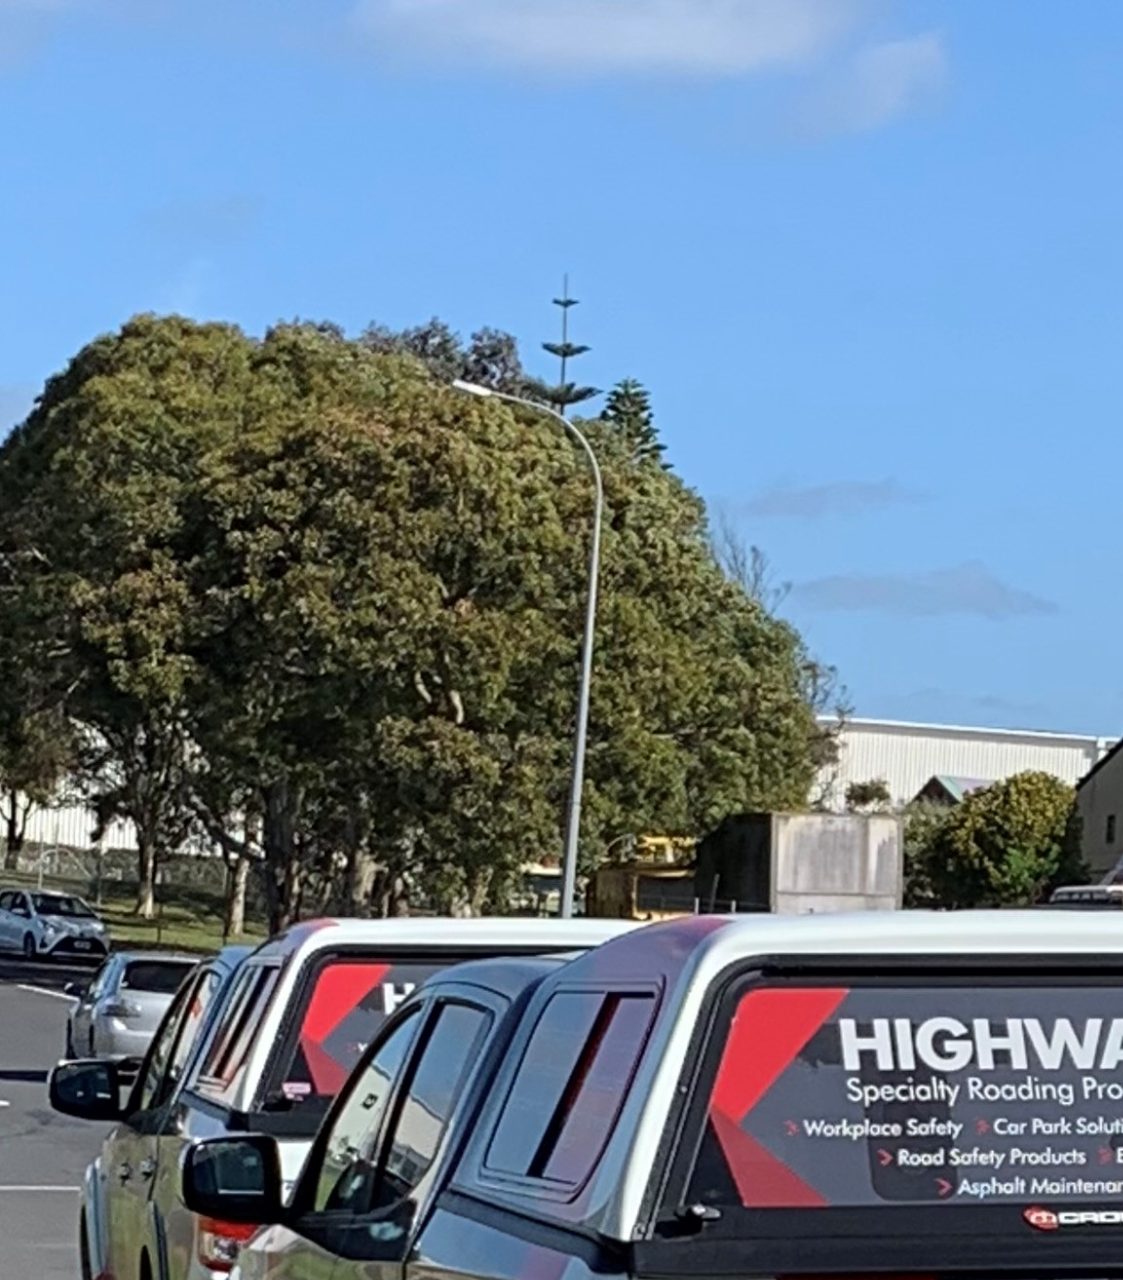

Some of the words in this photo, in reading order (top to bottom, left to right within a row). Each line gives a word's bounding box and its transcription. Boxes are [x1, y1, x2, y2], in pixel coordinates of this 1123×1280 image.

[846, 1076, 961, 1107] Specialty
[968, 1075, 1075, 1106] Roading
[803, 1118, 902, 1141] Workplace
[906, 1117, 963, 1139] Safety
[993, 1117, 1028, 1136] Car
[1032, 1117, 1071, 1135] Park
[897, 1148, 945, 1167] Road
[948, 1147, 1005, 1170] Safety
[1009, 1146, 1087, 1166] Products
[957, 1176, 1026, 1198] Asphalt
